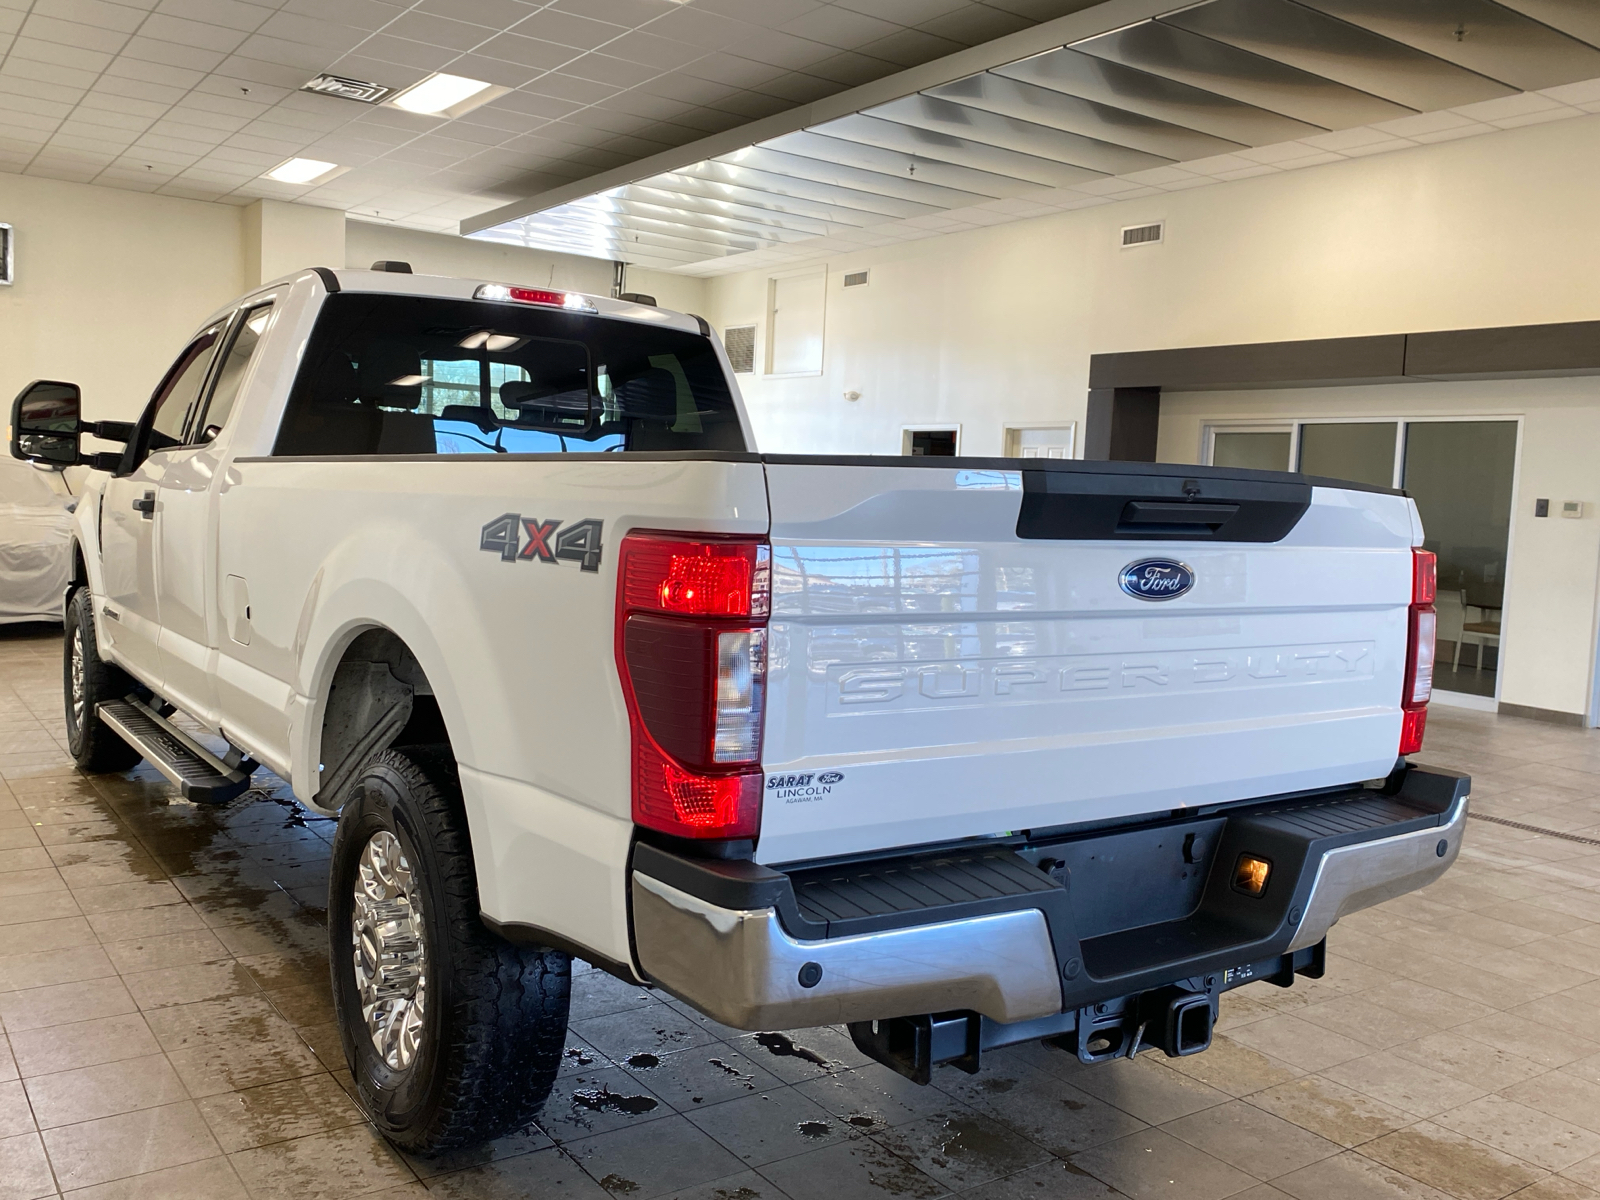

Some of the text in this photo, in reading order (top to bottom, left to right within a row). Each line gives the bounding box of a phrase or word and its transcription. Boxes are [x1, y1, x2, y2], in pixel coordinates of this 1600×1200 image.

[480, 513, 604, 574] 4X4
[1140, 566, 1181, 591] Ford
[839, 648, 1369, 705] SUPER DUTY
[766, 773, 815, 789] SARAT
[777, 786, 832, 798] LINCOLN
